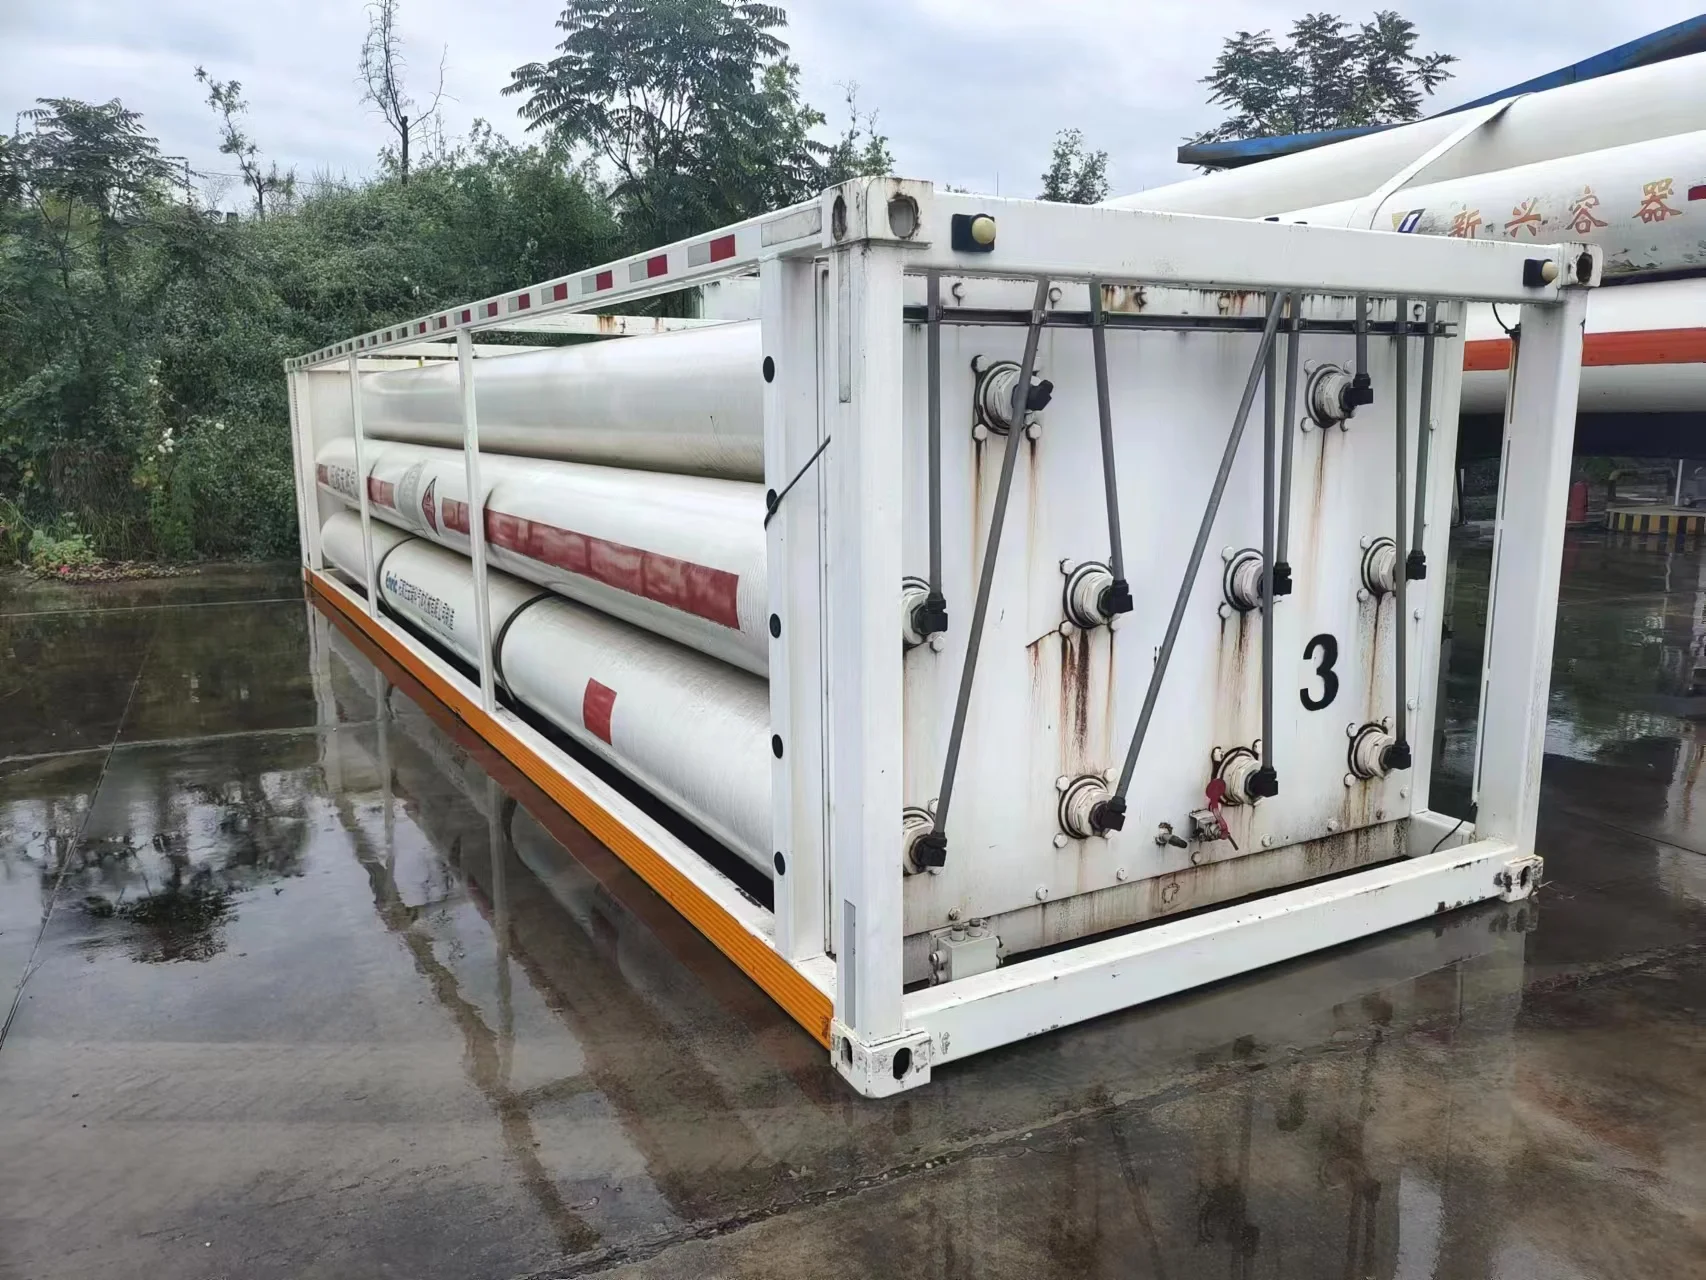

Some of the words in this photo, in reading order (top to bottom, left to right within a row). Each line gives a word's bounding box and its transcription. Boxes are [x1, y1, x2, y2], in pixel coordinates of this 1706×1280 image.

[1448, 178, 1682, 239] 新兴容器
[1300, 633, 1339, 711] 3
